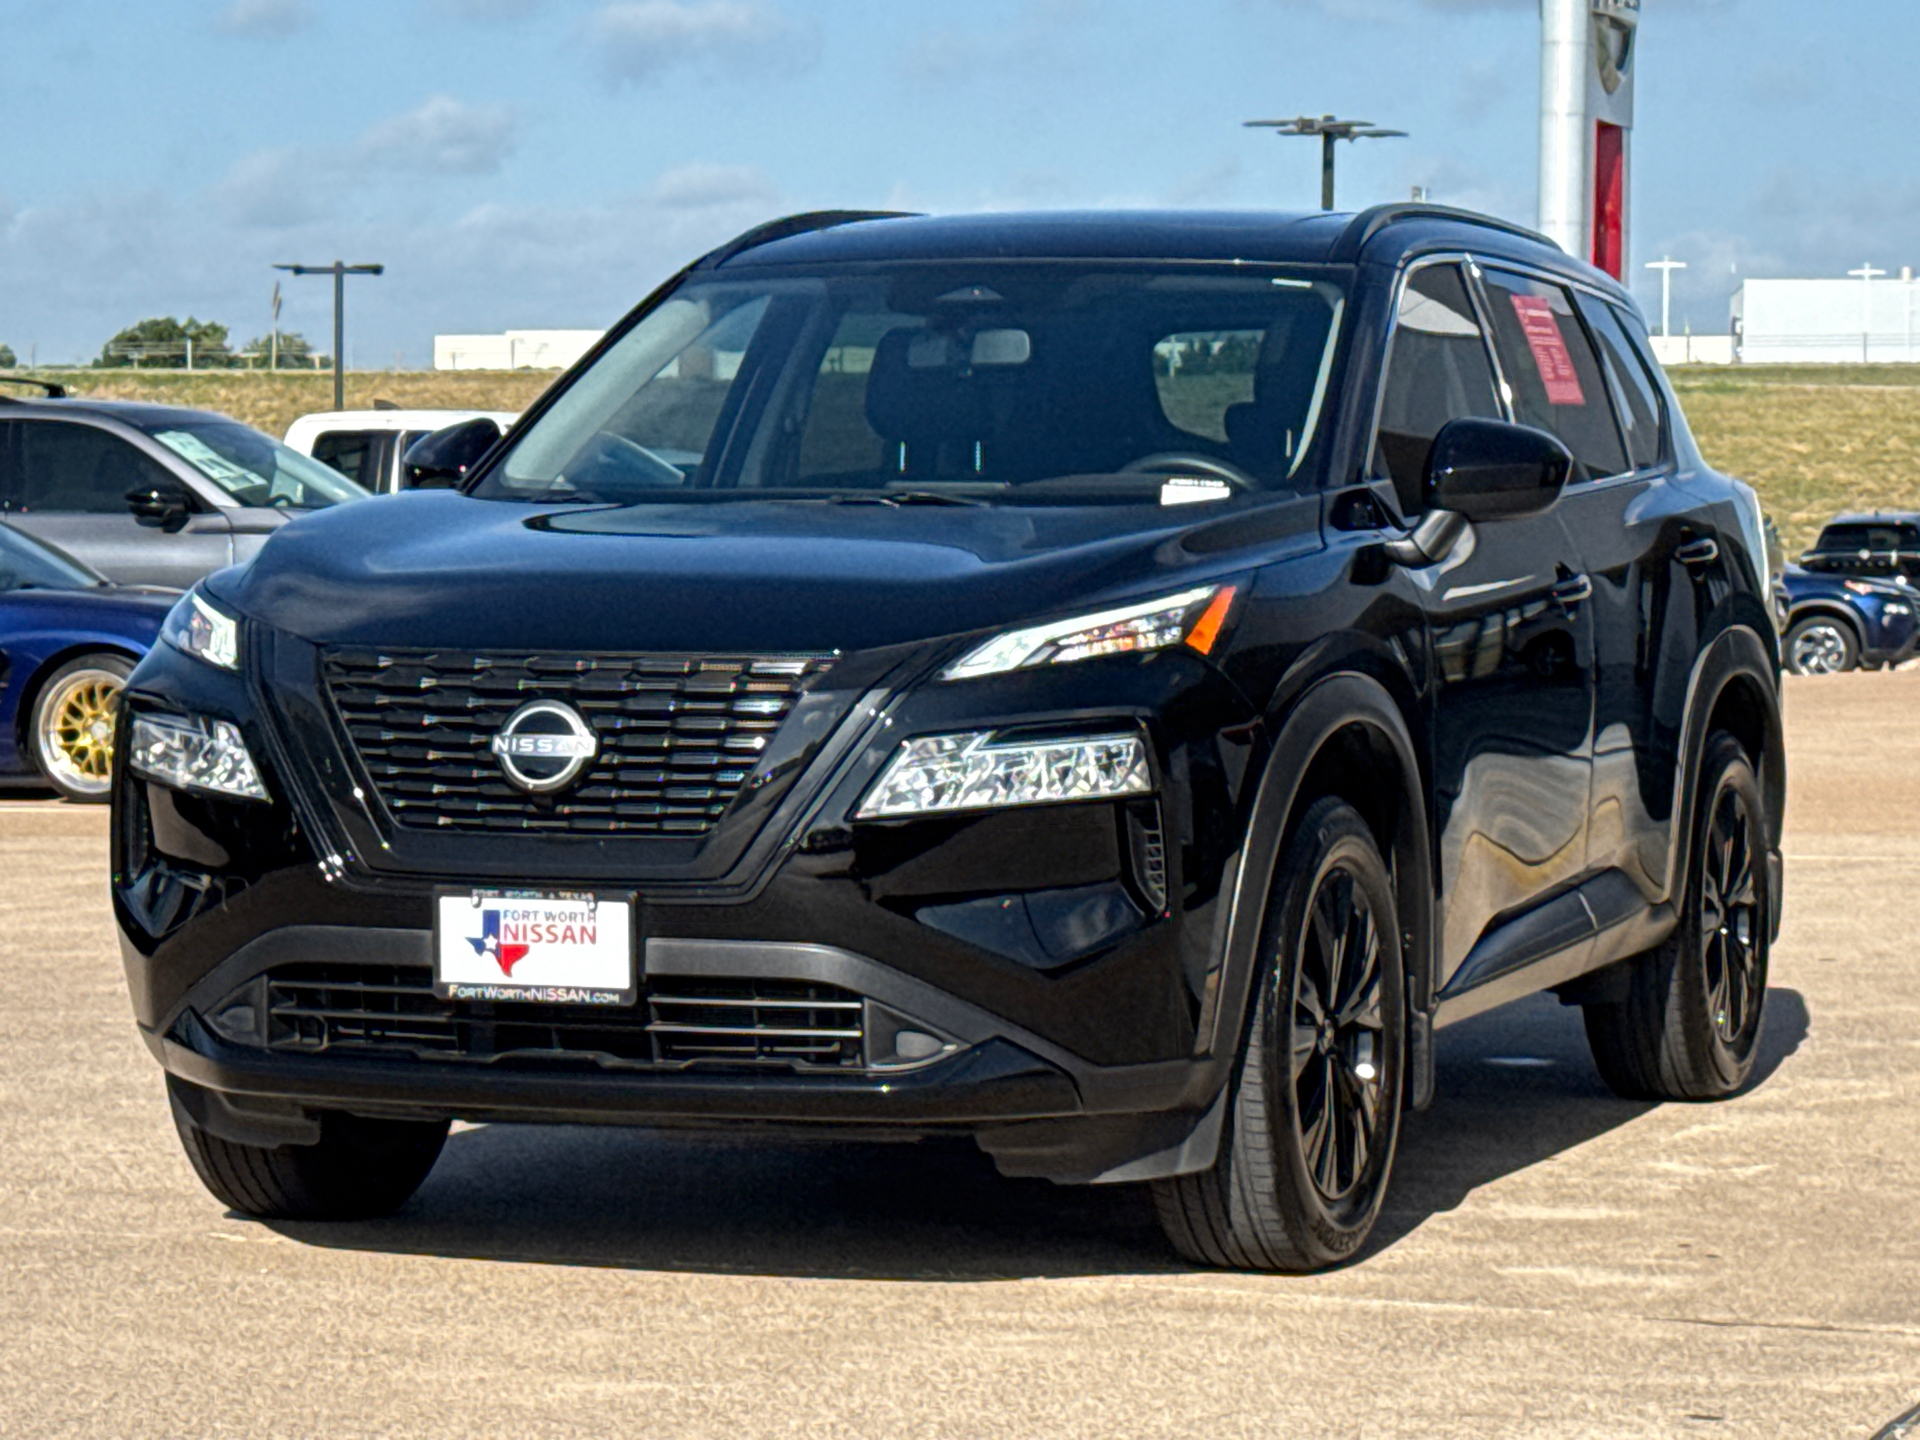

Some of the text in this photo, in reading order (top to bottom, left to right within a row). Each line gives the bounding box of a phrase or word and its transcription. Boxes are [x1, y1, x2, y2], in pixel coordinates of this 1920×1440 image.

[494, 737, 592, 753] NISSAN
[503, 909, 597, 924] FORT WORTH
[503, 923, 597, 945] NISSAN
